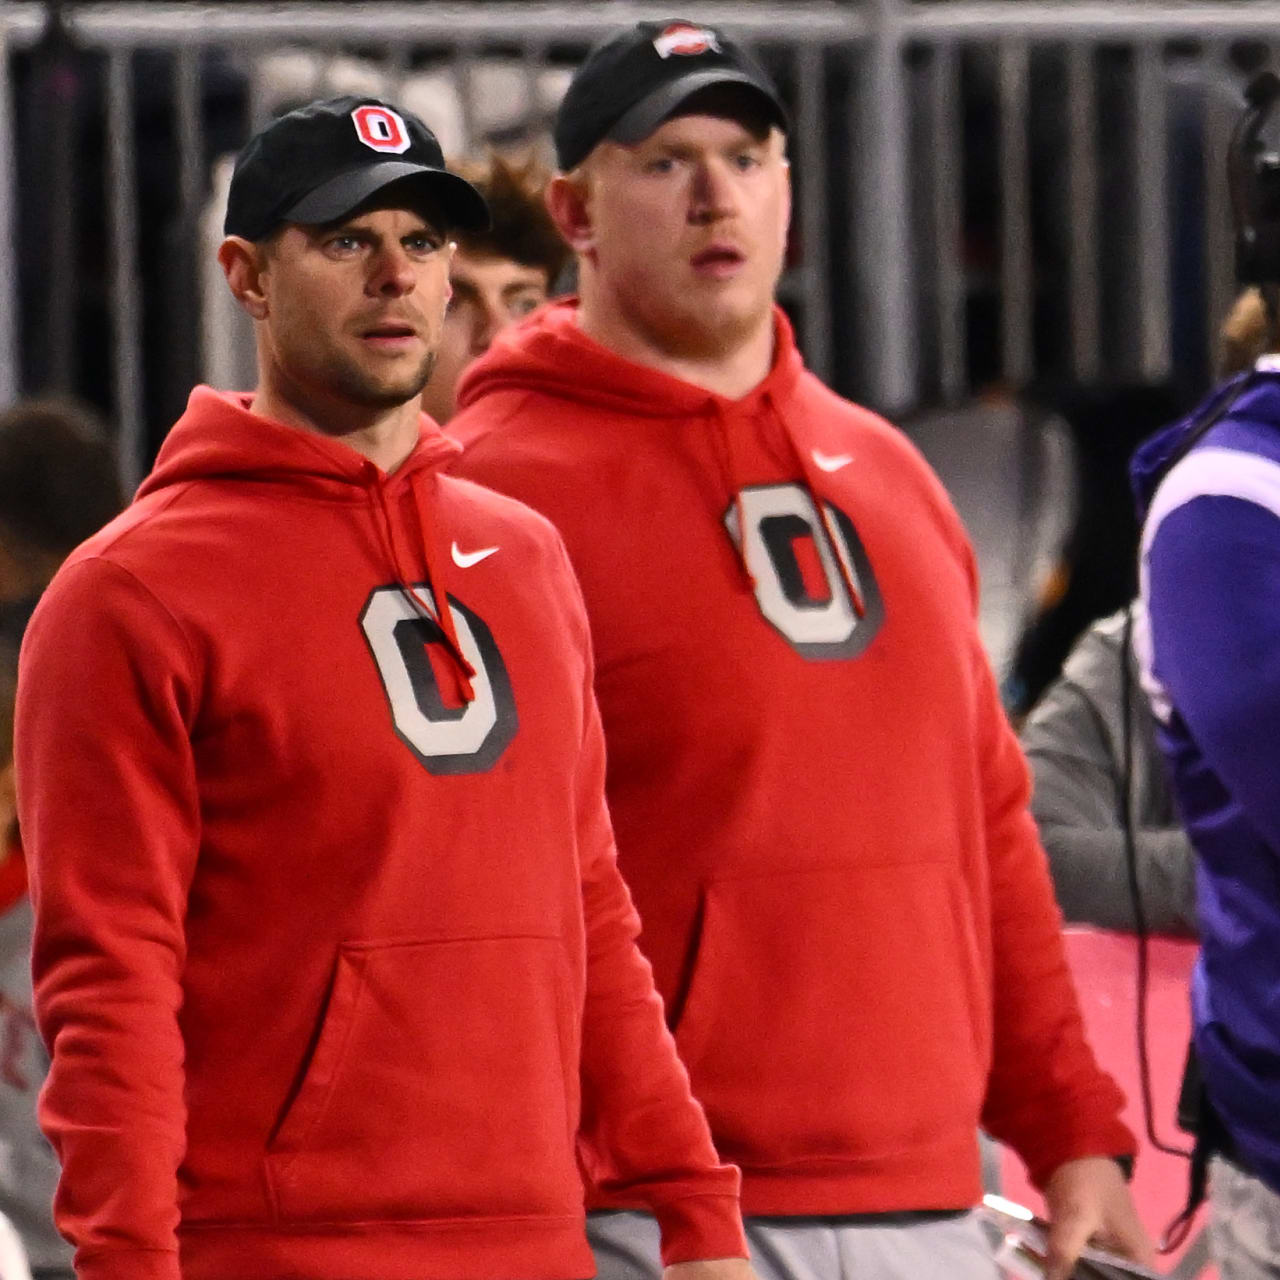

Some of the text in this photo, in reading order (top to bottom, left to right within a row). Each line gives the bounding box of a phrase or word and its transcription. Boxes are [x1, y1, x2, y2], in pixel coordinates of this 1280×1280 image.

[350, 105, 411, 155] O
[723, 481, 886, 662] O
[357, 581, 520, 776] O
